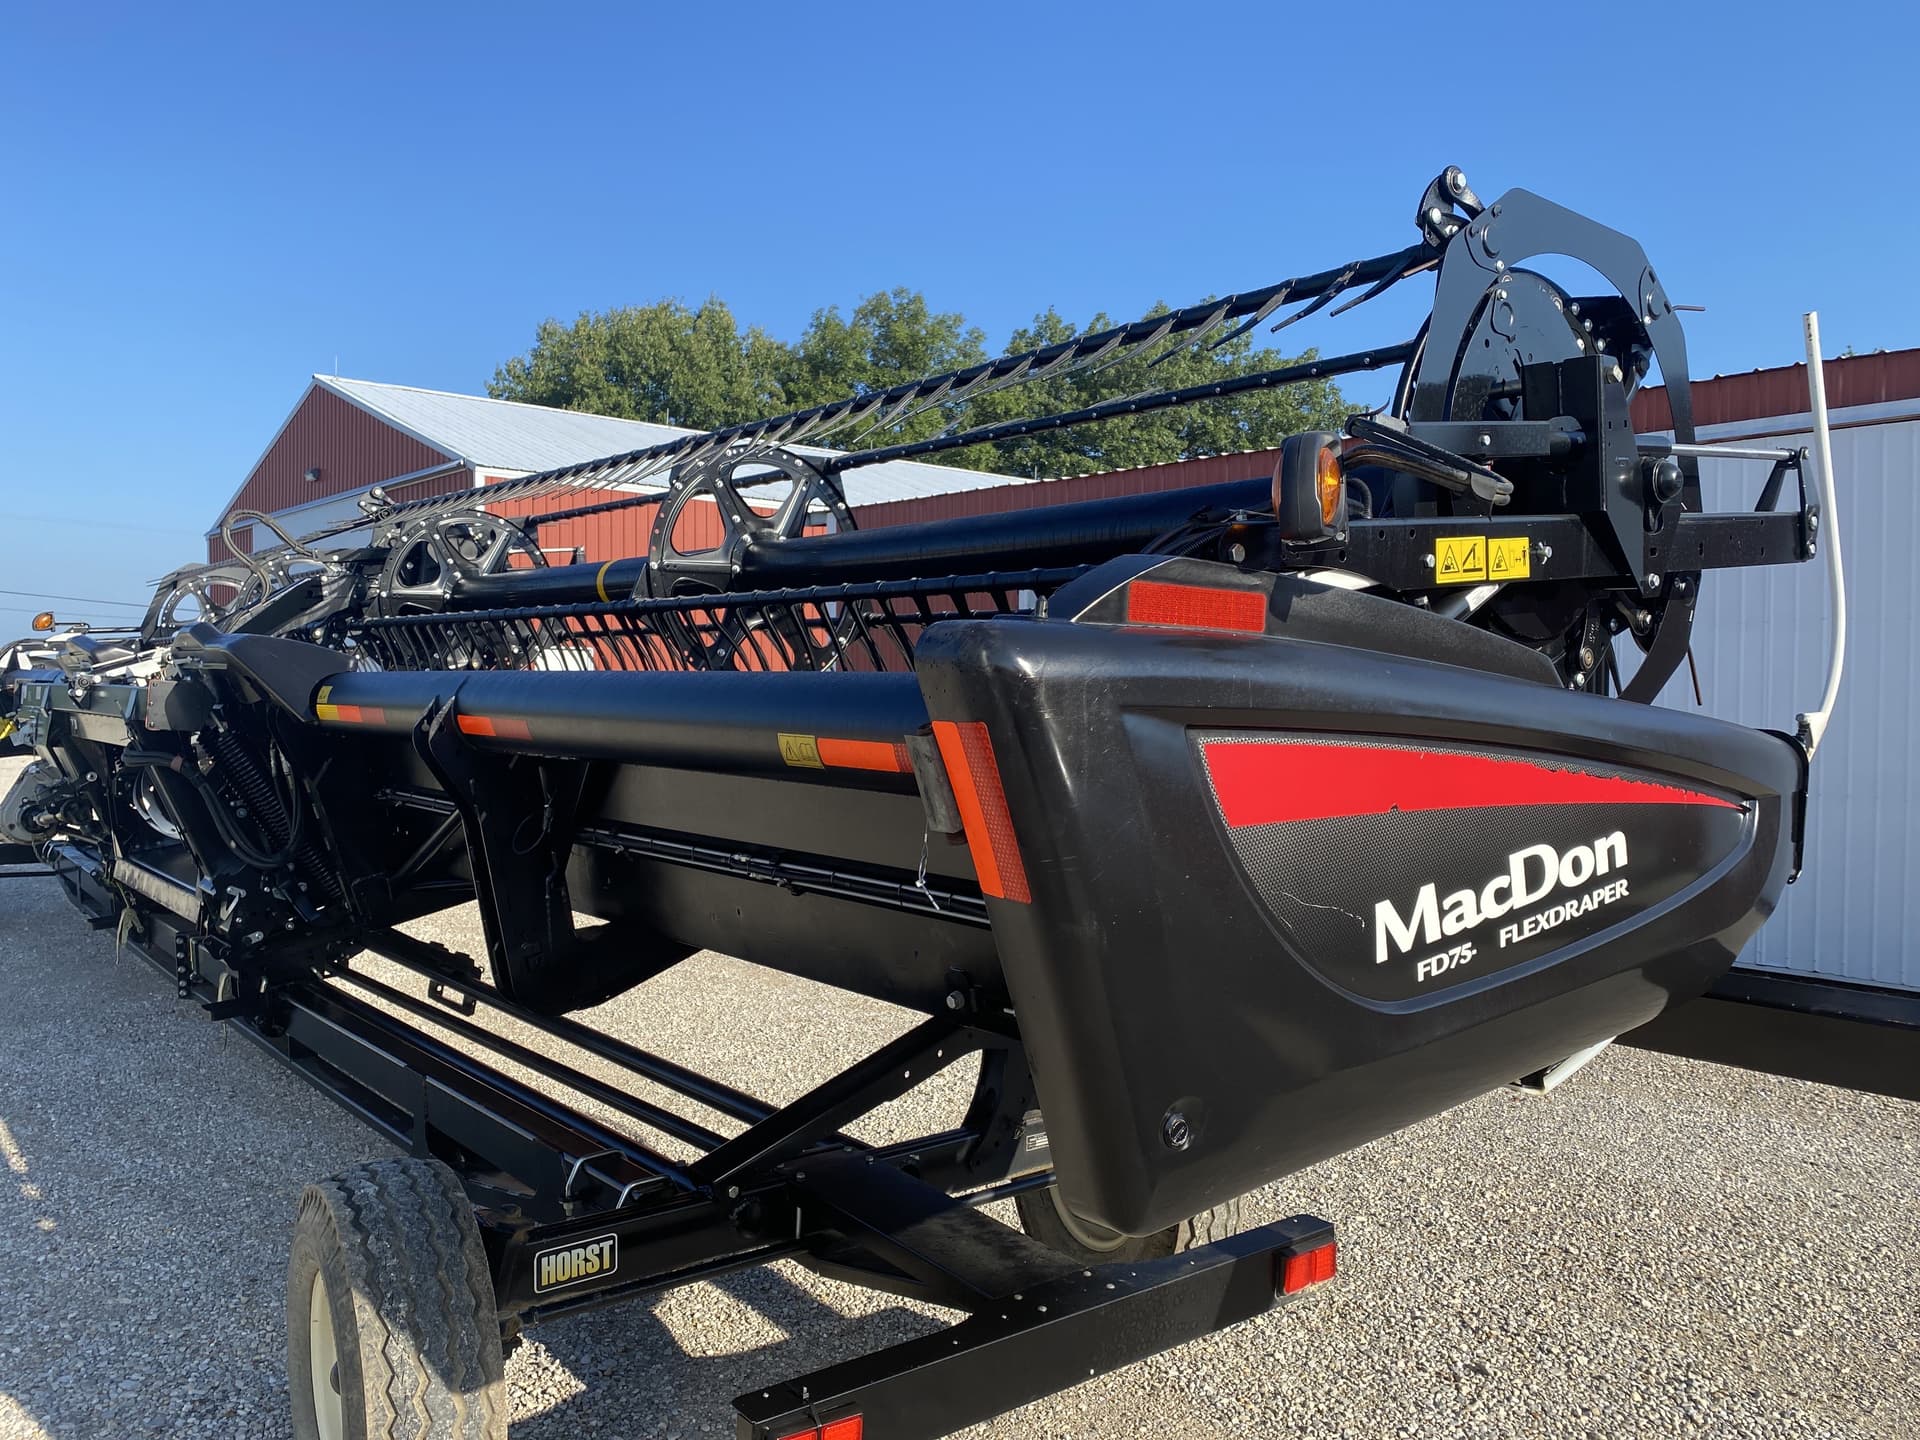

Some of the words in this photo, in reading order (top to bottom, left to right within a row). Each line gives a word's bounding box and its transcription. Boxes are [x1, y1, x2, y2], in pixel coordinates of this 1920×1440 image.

[1375, 831, 1628, 964] MacDon
[1499, 879, 1629, 948] FLEXDRAPER
[541, 1240, 613, 1286] HORST
